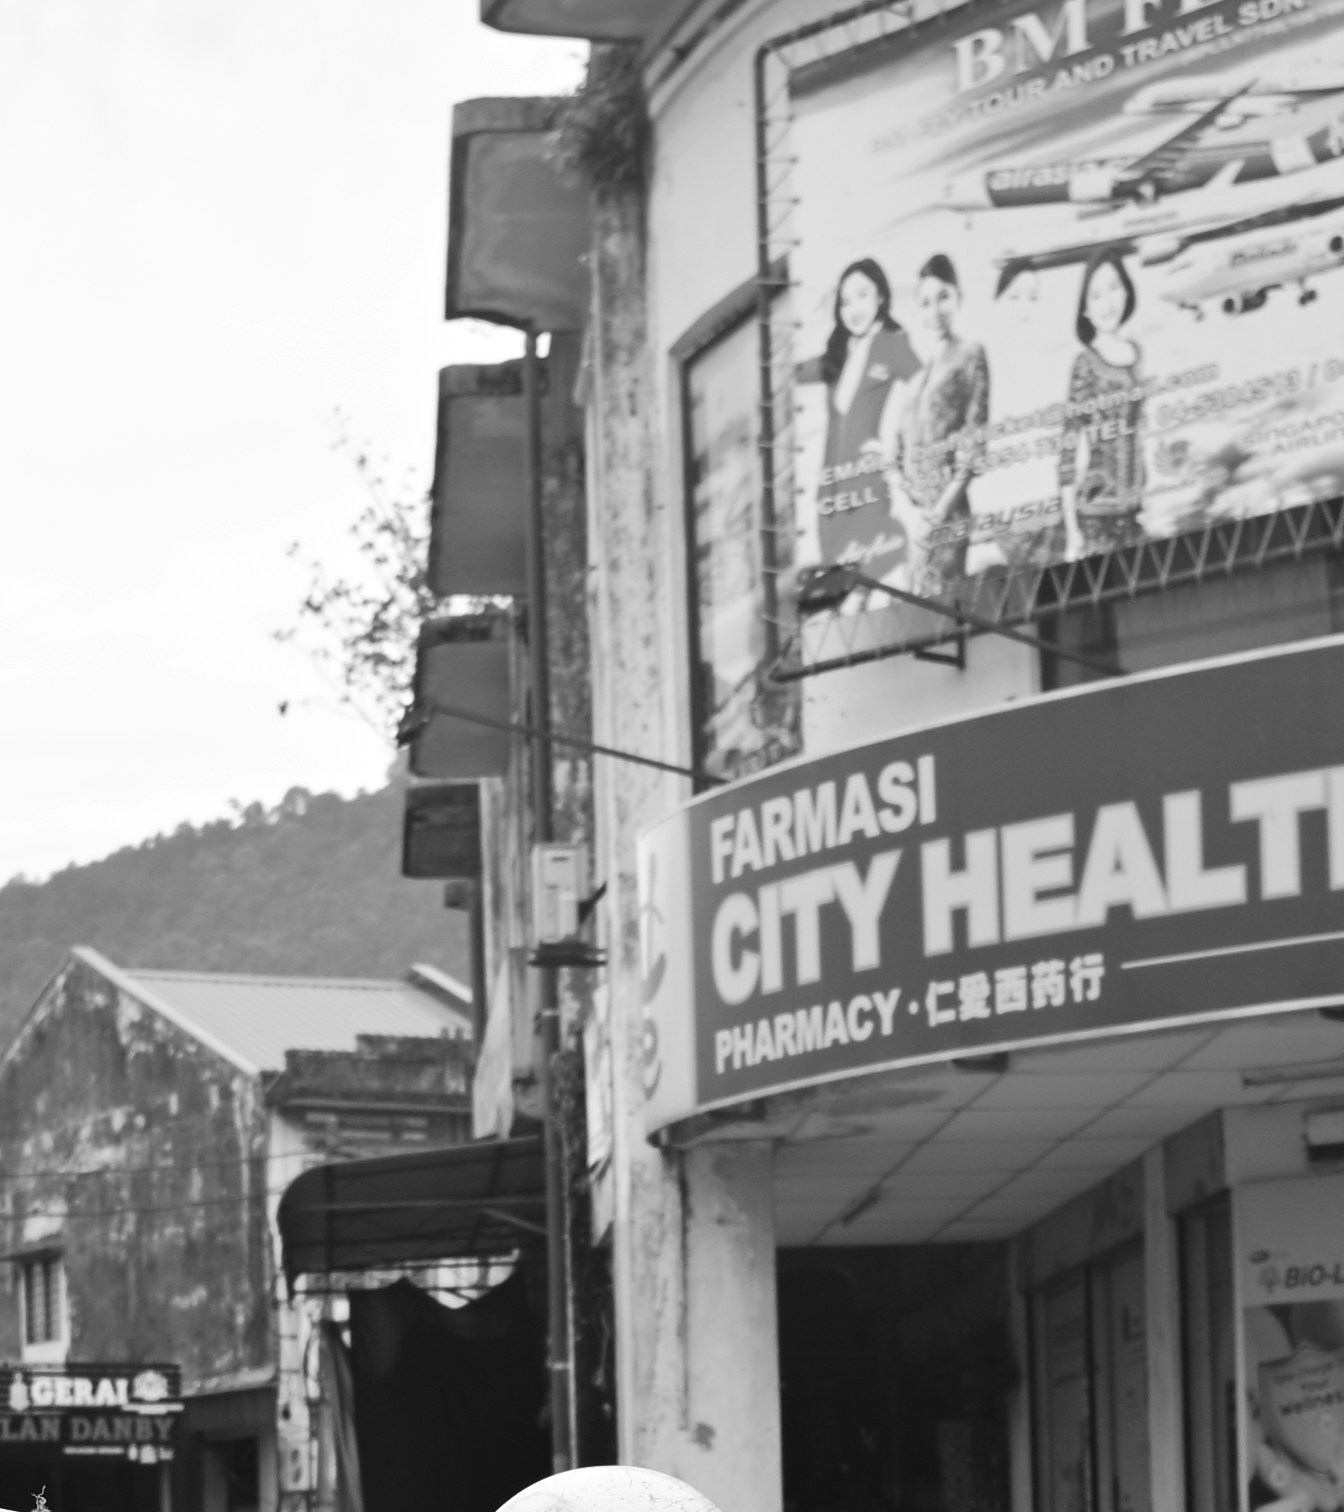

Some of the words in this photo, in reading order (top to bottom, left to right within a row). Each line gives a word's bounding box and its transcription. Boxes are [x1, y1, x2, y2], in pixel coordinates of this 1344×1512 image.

[969, 77, 1049, 118] TOUR
[1053, 54, 1116, 94] AND
[1121, 11, 1234, 68] TRAVEL
[820, 488, 879, 516] CELL
[1086, 419, 1133, 441] TEL
[930, 498, 1063, 545] malaysia
[710, 753, 938, 885] FARMASI
[710, 848, 904, 1007] CITY
[715, 988, 903, 1075] PHARMACY
[31, 1377, 128, 1406] GERAI
[71, 1417, 175, 1441] DANBY
